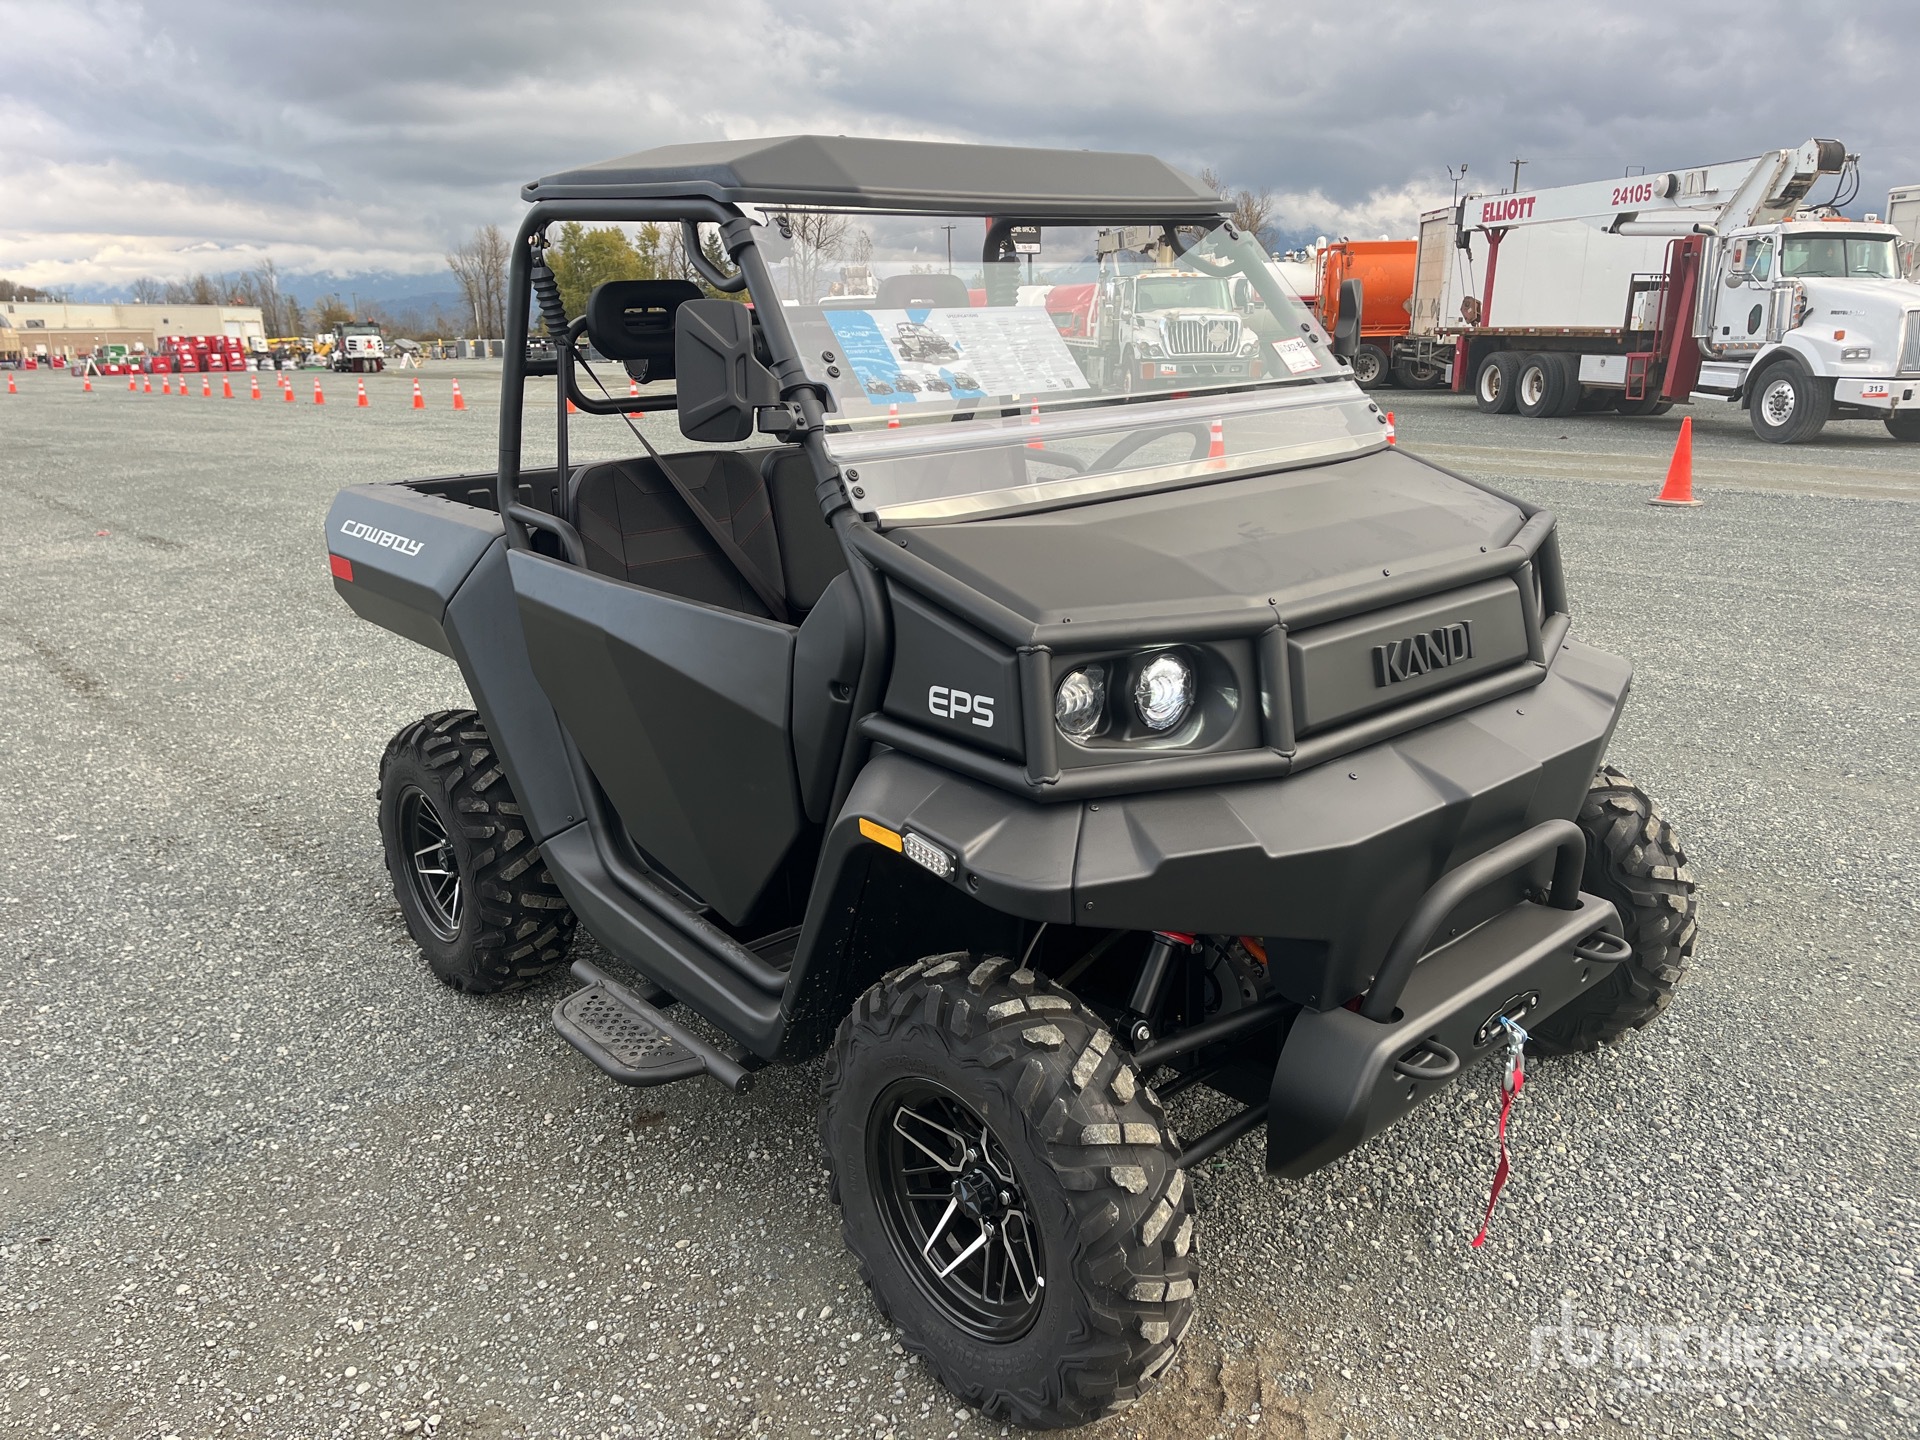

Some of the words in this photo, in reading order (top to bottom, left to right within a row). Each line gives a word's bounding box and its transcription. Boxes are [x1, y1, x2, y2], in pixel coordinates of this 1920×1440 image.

[1482, 196, 1536, 223] ELLIOTT
[1611, 183, 1652, 206] 24105
[1868, 385, 1884, 393] 313
[340, 519, 425, 556] COWBOY
[1372, 619, 1474, 688] KANDI
[928, 685, 995, 728] EPS
